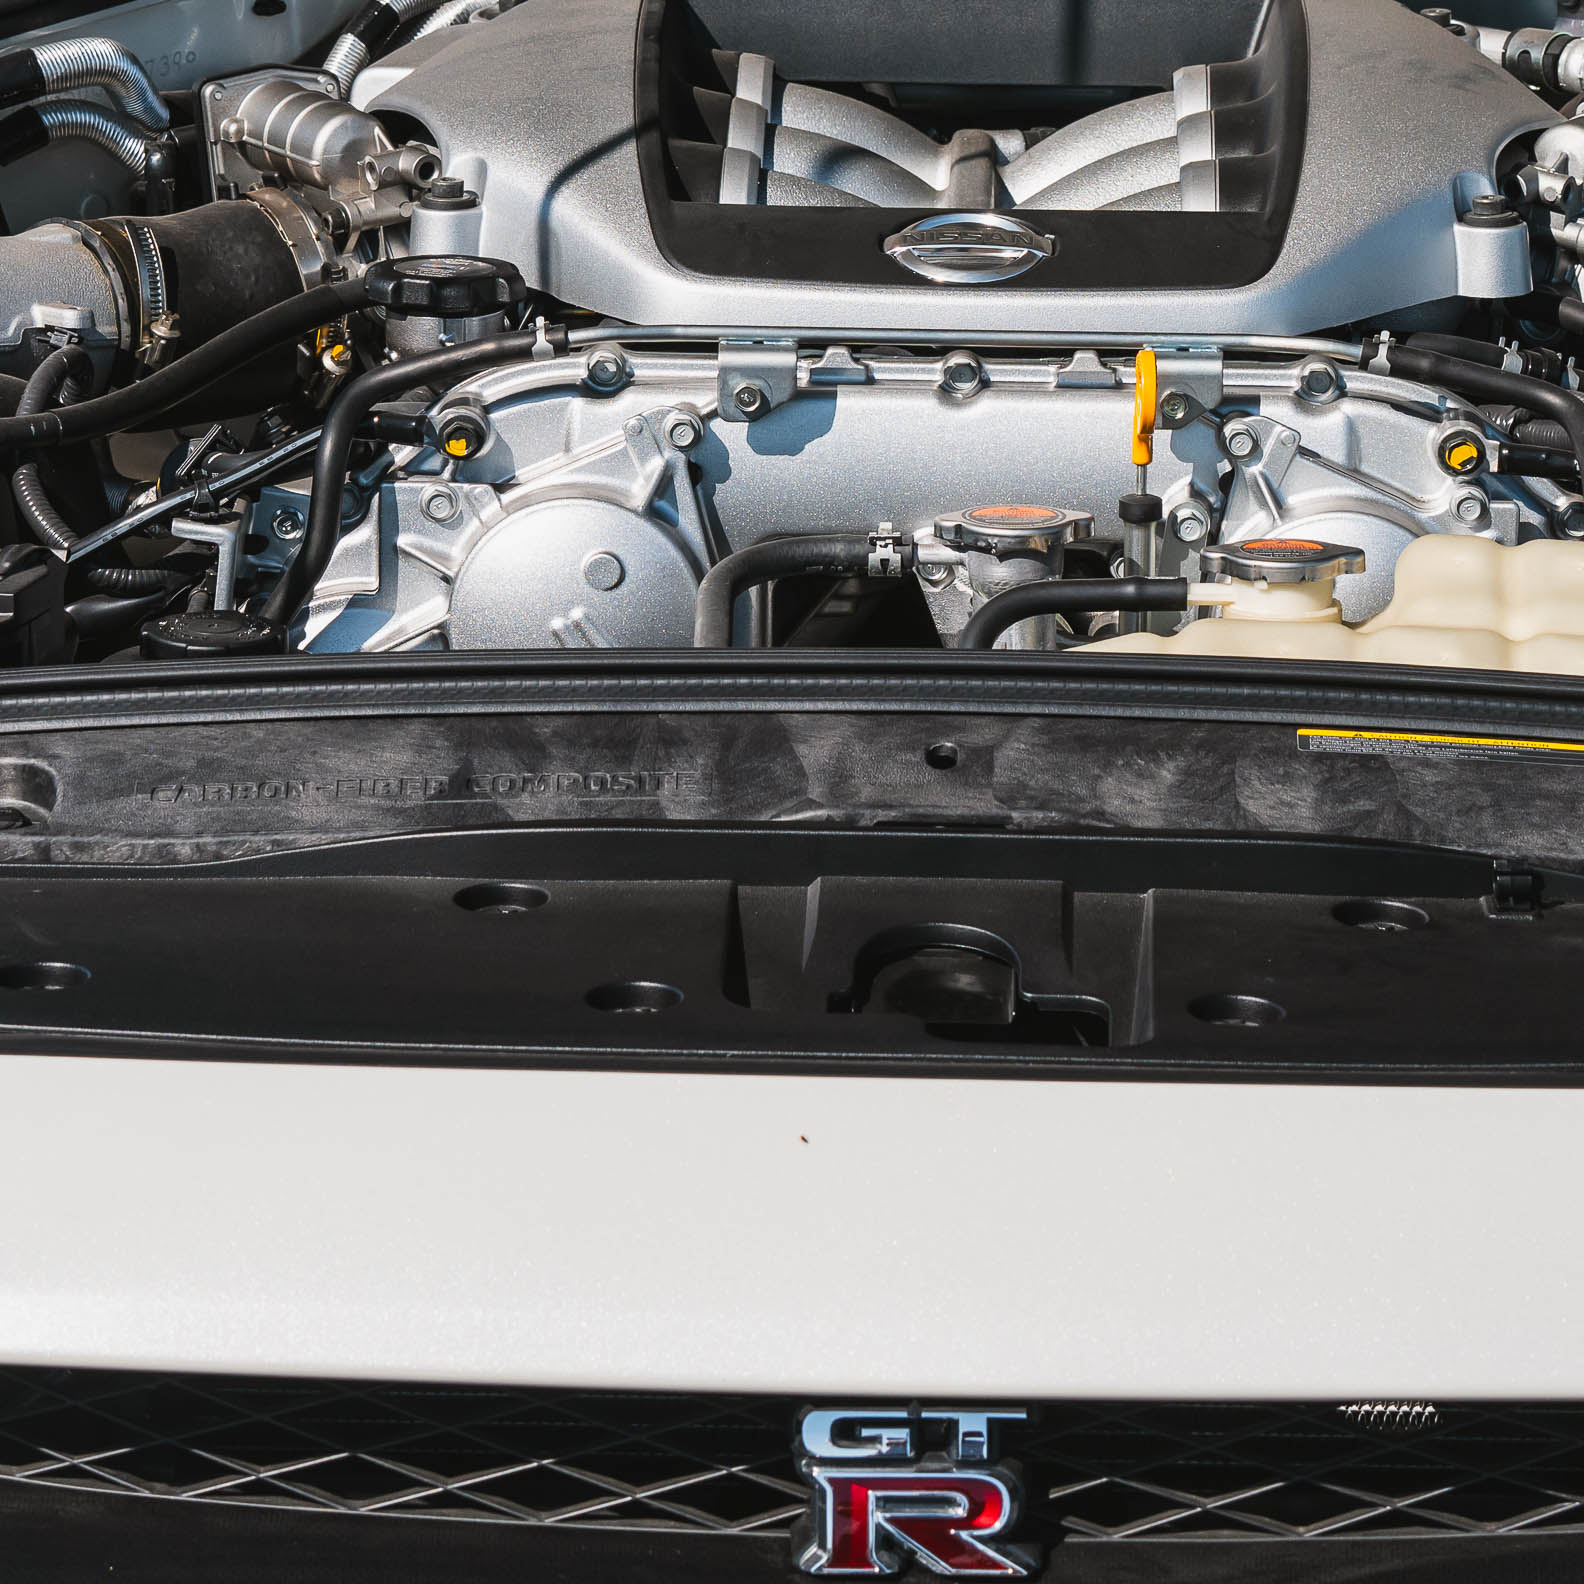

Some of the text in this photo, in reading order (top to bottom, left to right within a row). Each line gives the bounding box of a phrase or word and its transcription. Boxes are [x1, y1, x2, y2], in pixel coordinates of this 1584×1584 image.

[904, 230, 1035, 245] NISSAN
[150, 771, 698, 804] CARBON-FIBER COMPOSITE
[801, 1406, 1028, 1460] GT
[810, 1468, 1028, 1576] R
